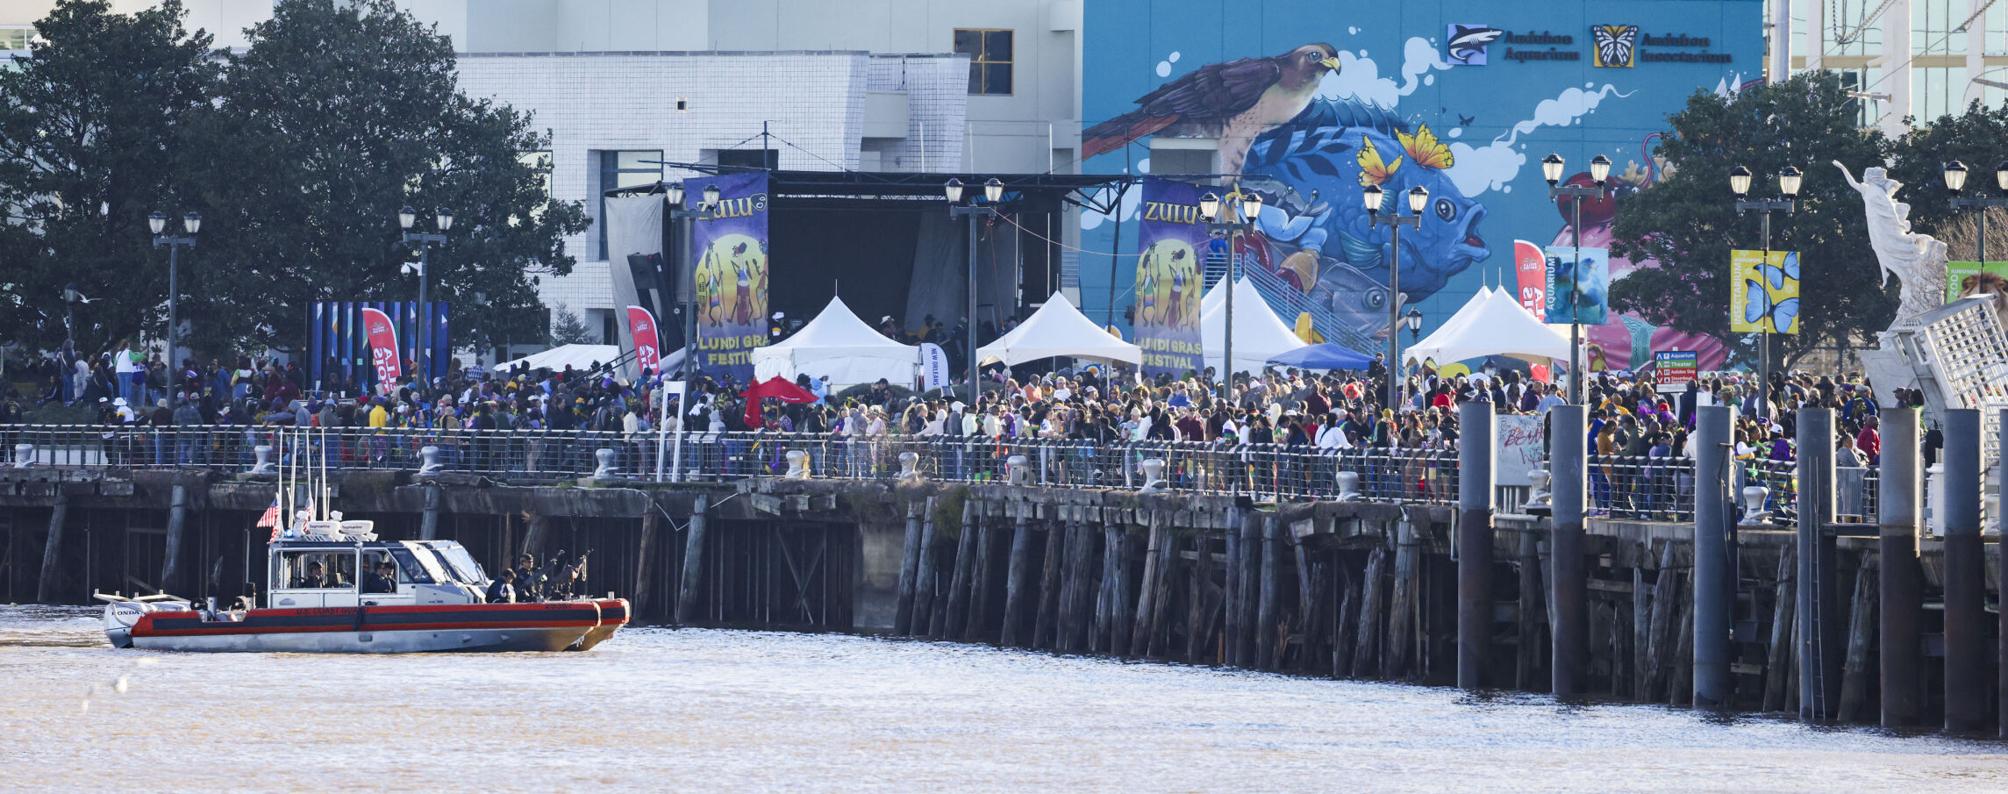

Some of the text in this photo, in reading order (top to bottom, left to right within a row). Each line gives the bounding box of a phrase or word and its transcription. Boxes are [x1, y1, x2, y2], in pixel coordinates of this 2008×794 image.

[1504, 31, 1573, 45] Audubon
[1642, 33, 1710, 47] Audubon
[1504, 47, 1580, 63] Aquarium
[1641, 49, 1732, 63] Insectarium
[697, 197, 753, 219] ZULU
[1145, 202, 1197, 224] ZULU
[1547, 257, 1556, 310] AQUARIUM
[1950, 274, 1959, 297] ZOO
[699, 333, 770, 350] LUNDI GRA
[1133, 336, 1202, 355] LUNDI GRAS
[707, 351, 754, 365] FESTIV
[1142, 353, 1196, 369] FESTIVAL
[932, 361, 940, 386] ORLEANS
